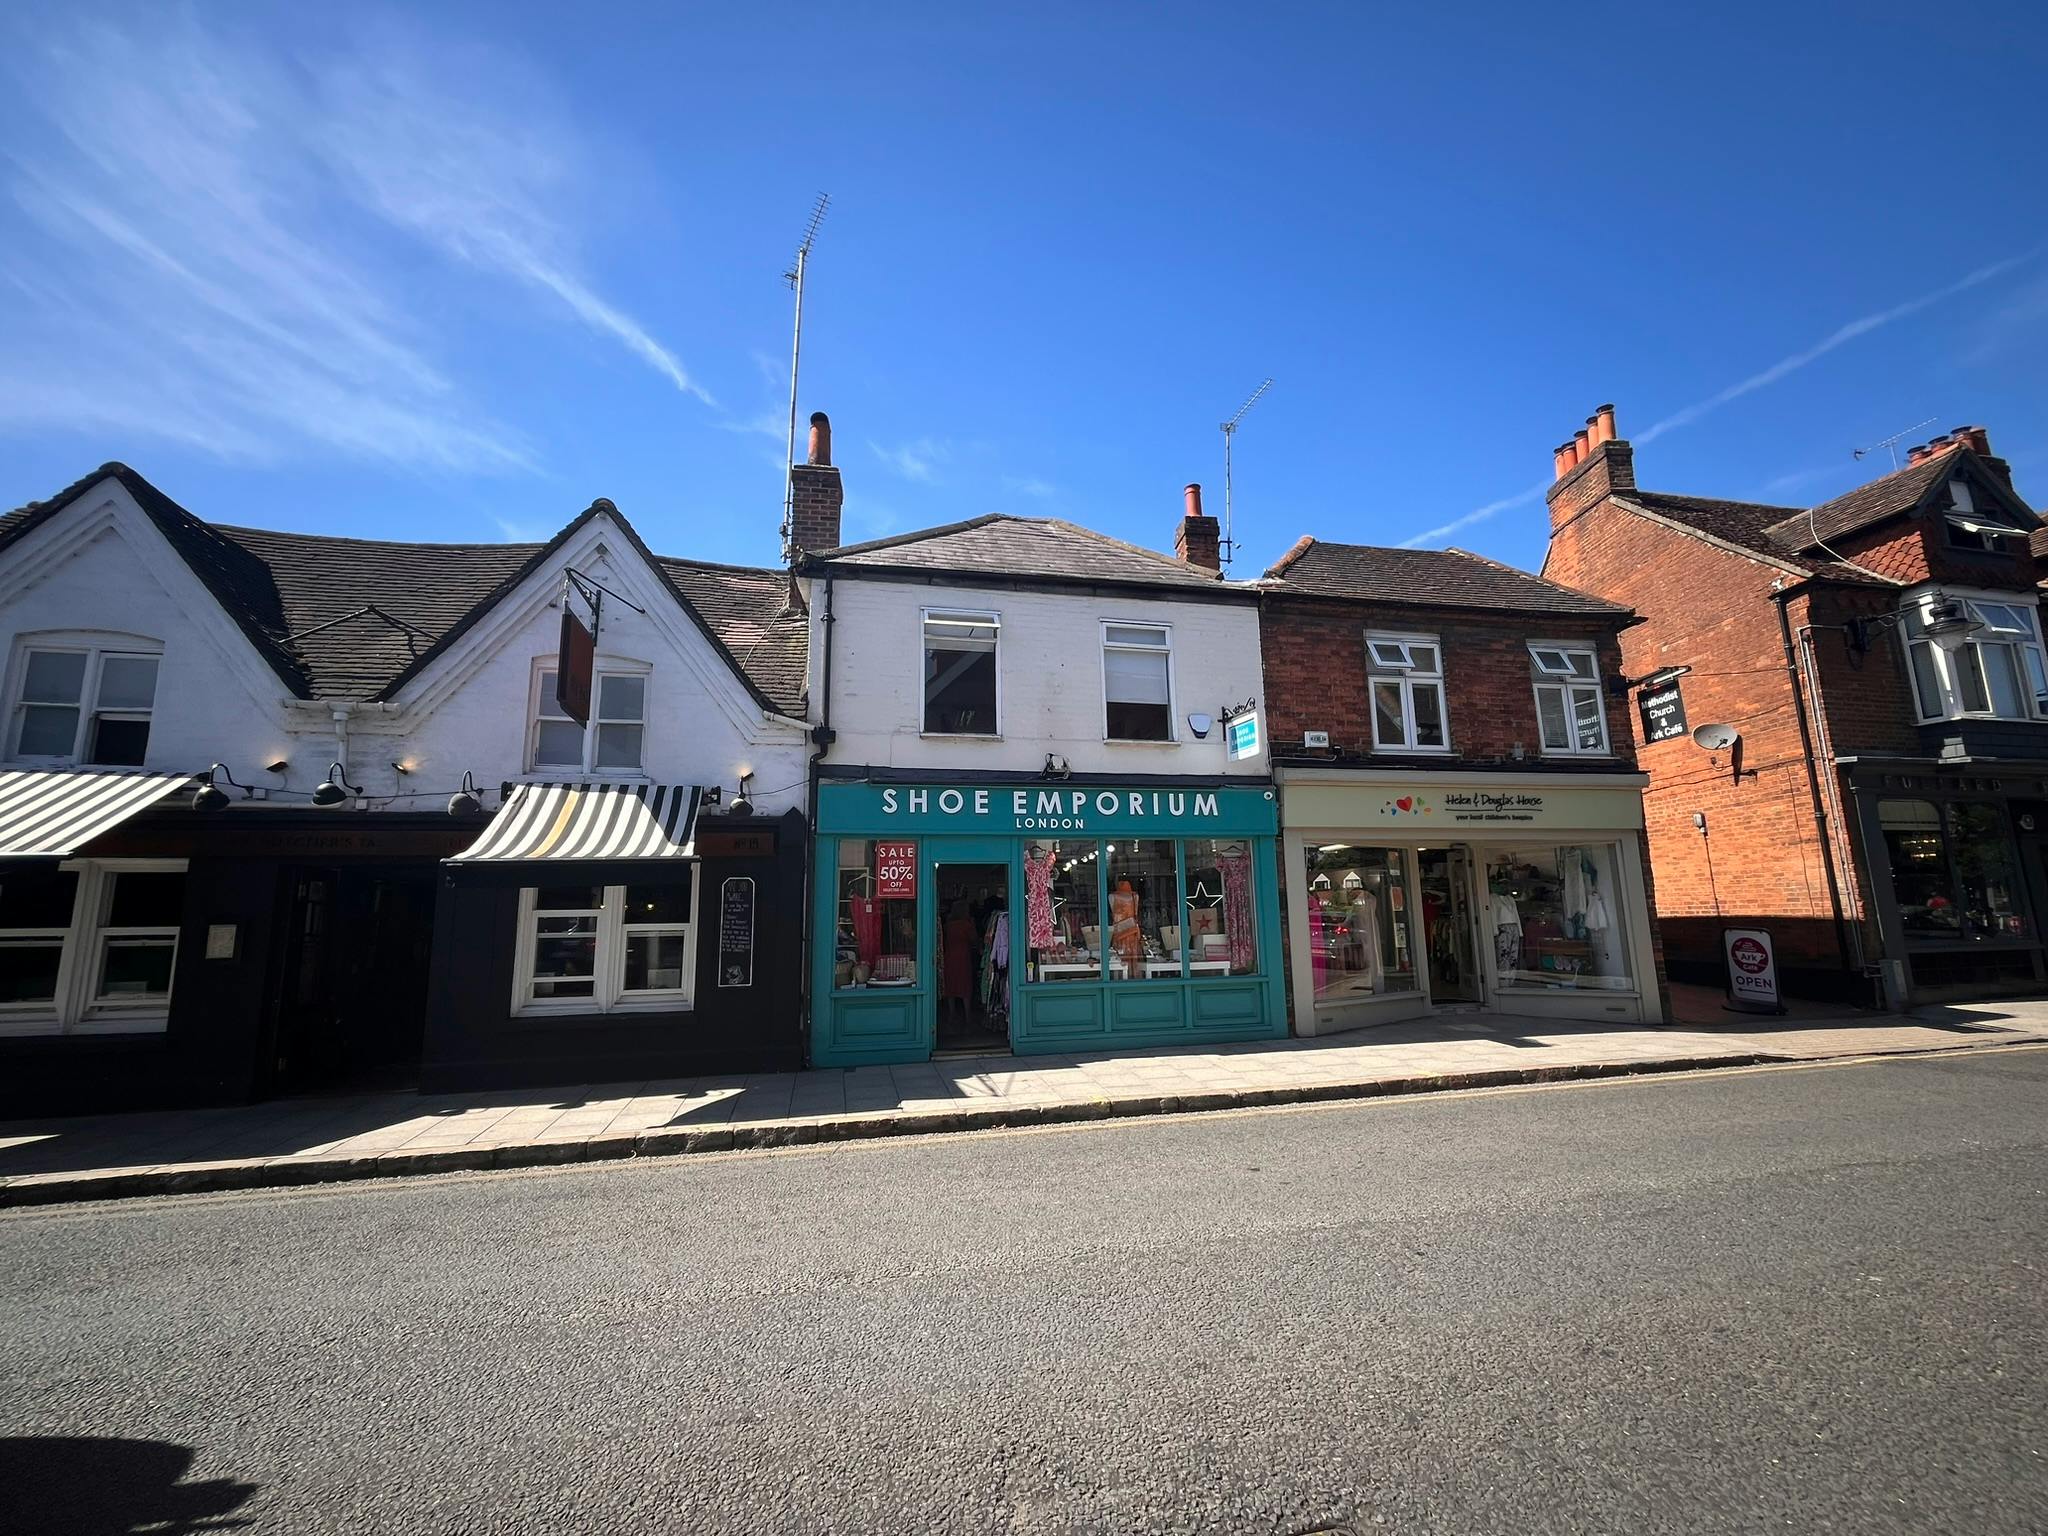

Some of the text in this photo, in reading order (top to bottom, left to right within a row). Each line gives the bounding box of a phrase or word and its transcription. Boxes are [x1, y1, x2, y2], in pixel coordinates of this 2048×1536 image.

[1641, 690, 1679, 710] Methodist
[1649, 704, 1675, 719] Church
[1660, 717, 1668, 727] &
[1650, 730, 1664, 741] Ark
[882, 788, 1219, 816] SHOE EMPORIUM
[1445, 794, 1471, 805] Helen
[1481, 793, 1514, 812] Douglas
[1516, 795, 1543, 806] House
[1016, 818, 1084, 829] LONDON
[880, 847, 914, 857] SALE
[880, 866, 913, 880] 50%
[1741, 953, 1757, 962] Ark
[1736, 976, 1772, 988] OPEN
